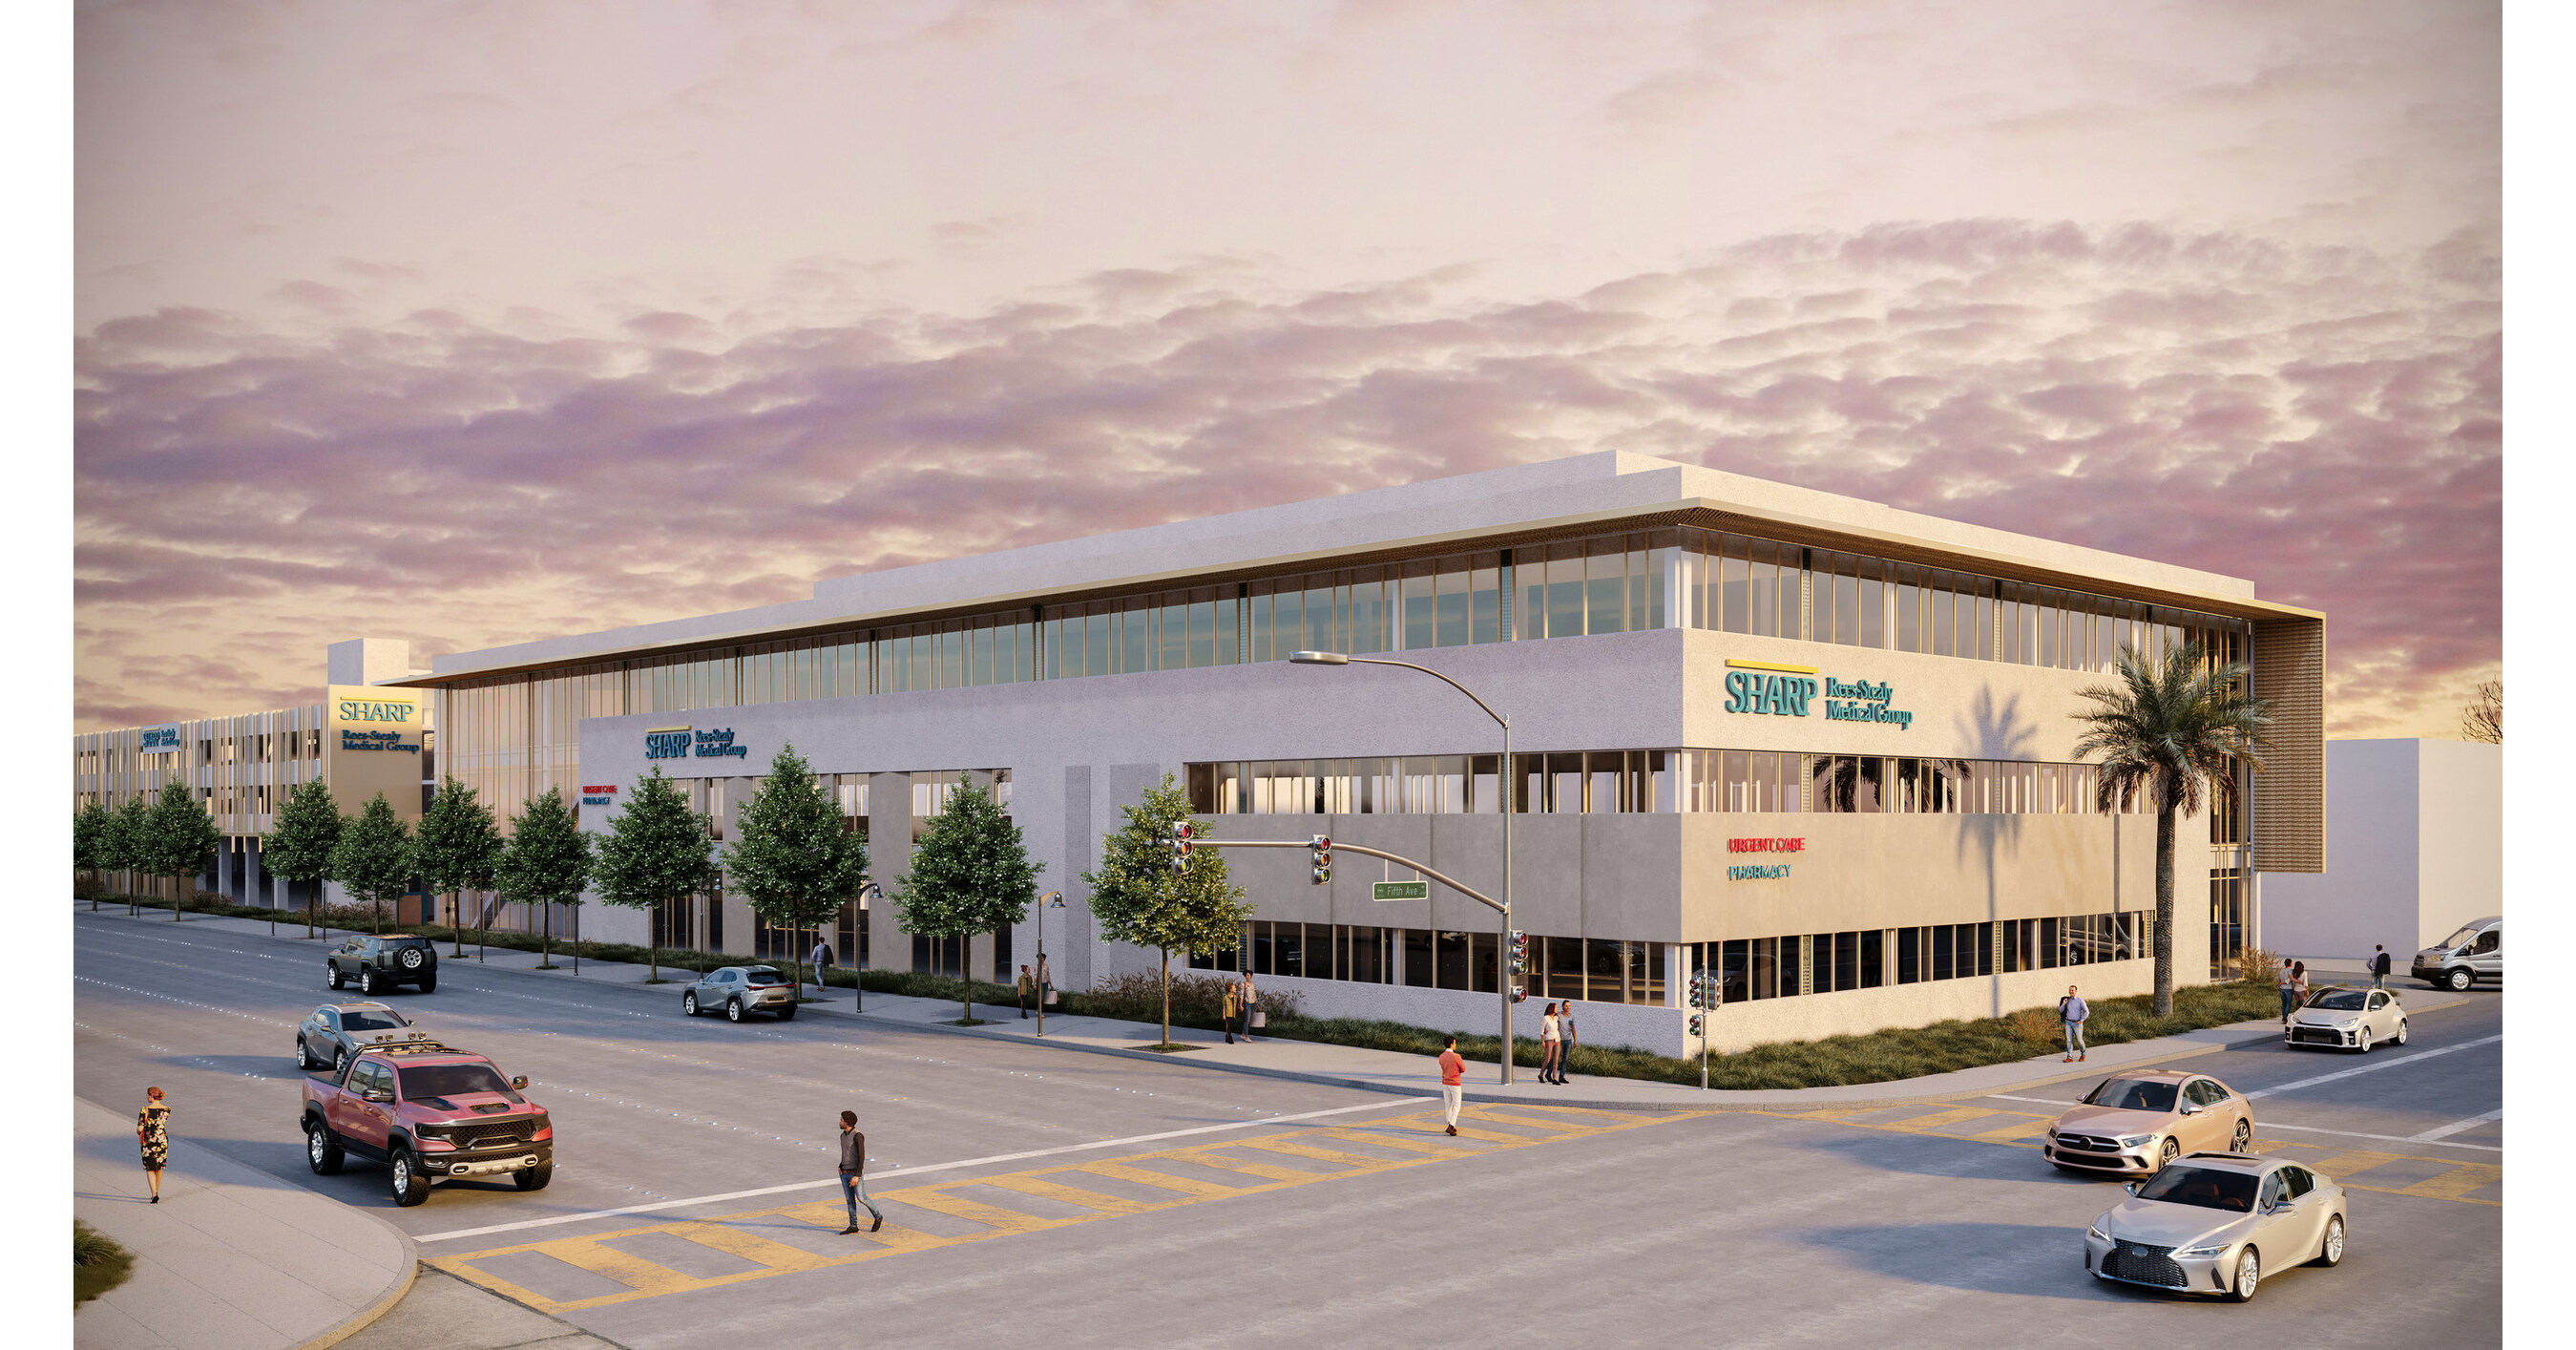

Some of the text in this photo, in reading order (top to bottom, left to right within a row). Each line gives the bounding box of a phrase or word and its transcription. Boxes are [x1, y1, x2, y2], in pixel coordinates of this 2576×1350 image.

[1725, 671, 1818, 716] SHARP
[1825, 677, 1894, 707] Rees-Stealy
[340, 702, 414, 722] SHARP
[1825, 700, 1913, 730] Medical Group
[342, 729, 401, 743] Rees-Stealy
[342, 740, 420, 754] Medical Group
[645, 732, 691, 759] SHARP
[1727, 837, 1806, 853] URGENT CARE
[1727, 864, 1791, 880] PHARMACY
[1387, 886, 1404, 896] Fifth
[1405, 885, 1418, 896] Ave
